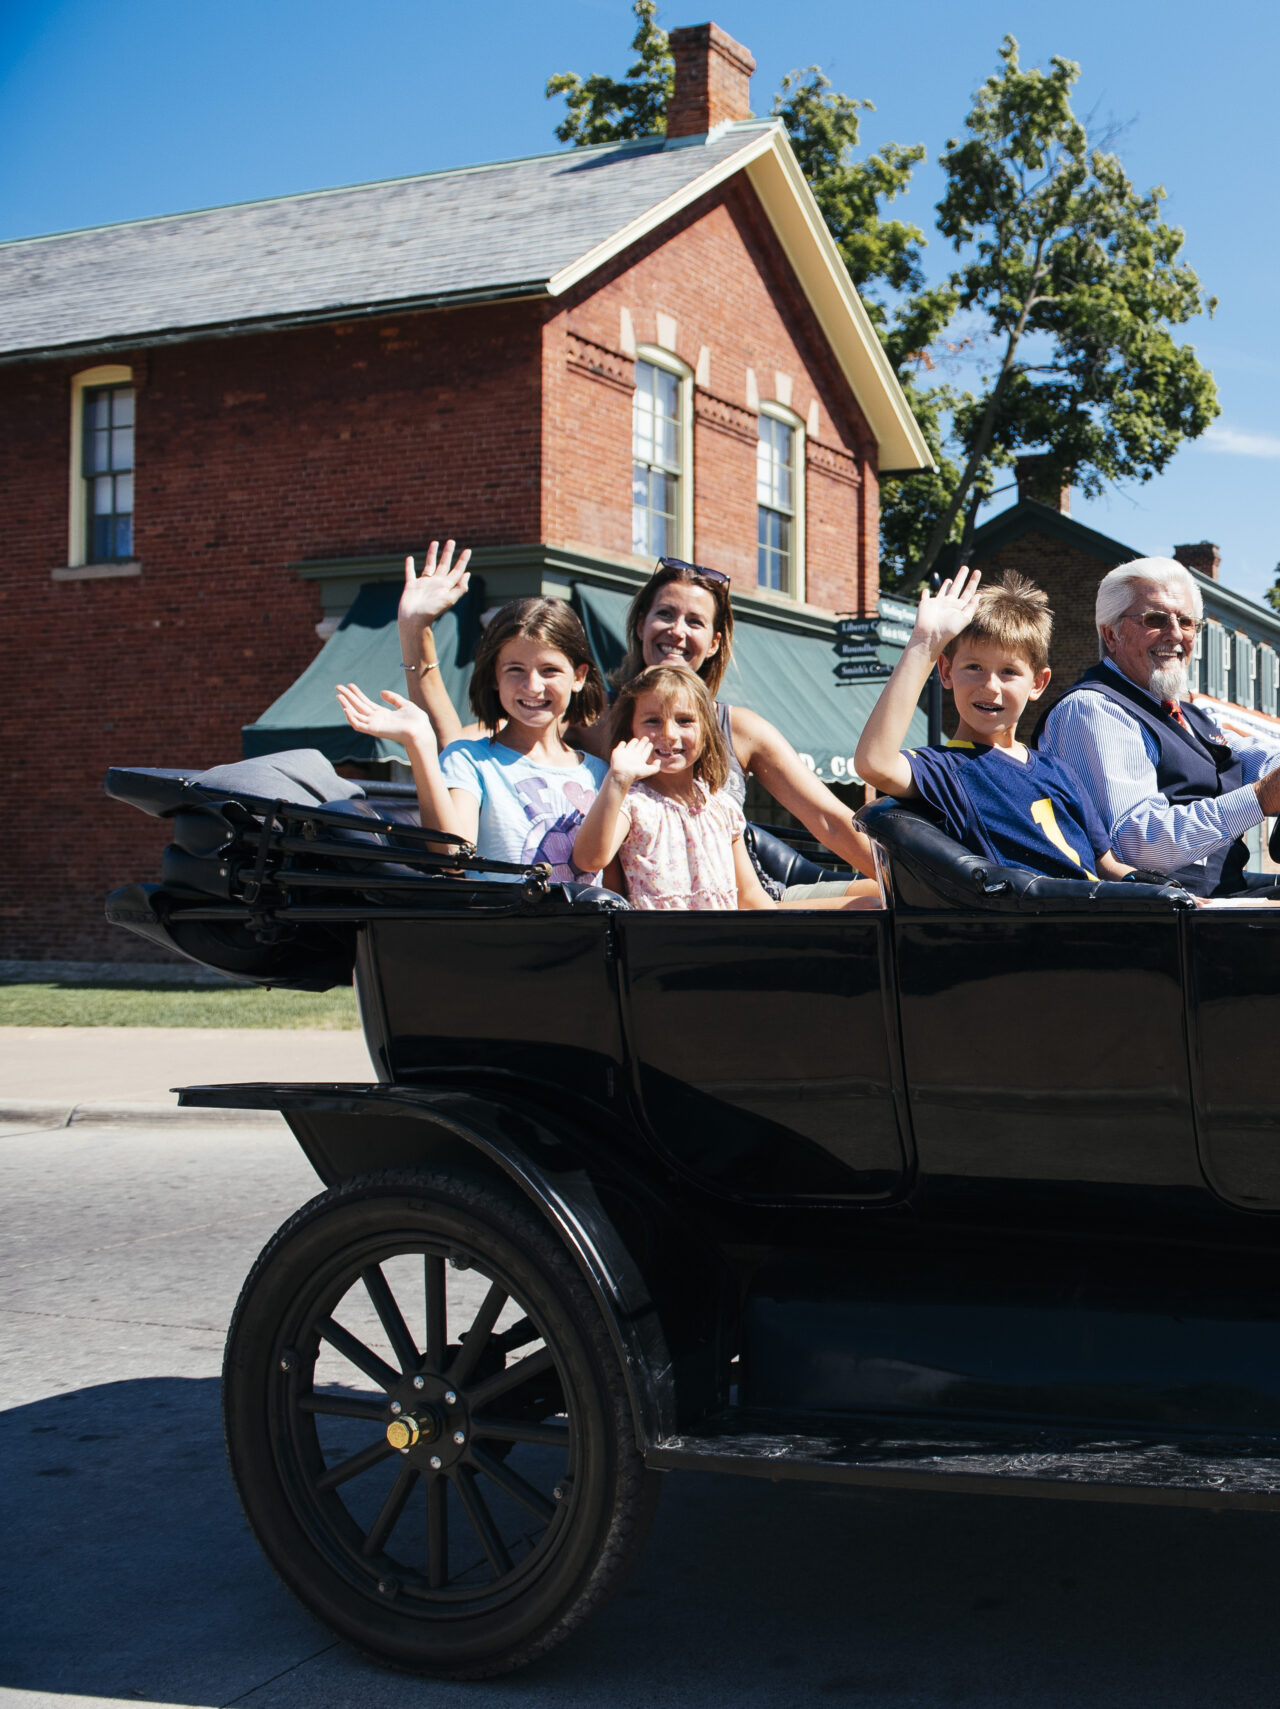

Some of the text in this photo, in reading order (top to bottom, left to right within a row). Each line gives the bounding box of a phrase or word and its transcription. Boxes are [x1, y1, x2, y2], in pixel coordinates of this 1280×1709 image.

[842, 621, 869, 633] Liberty
[841, 664, 868, 675] Smith's
[831, 756, 860, 777] CO
